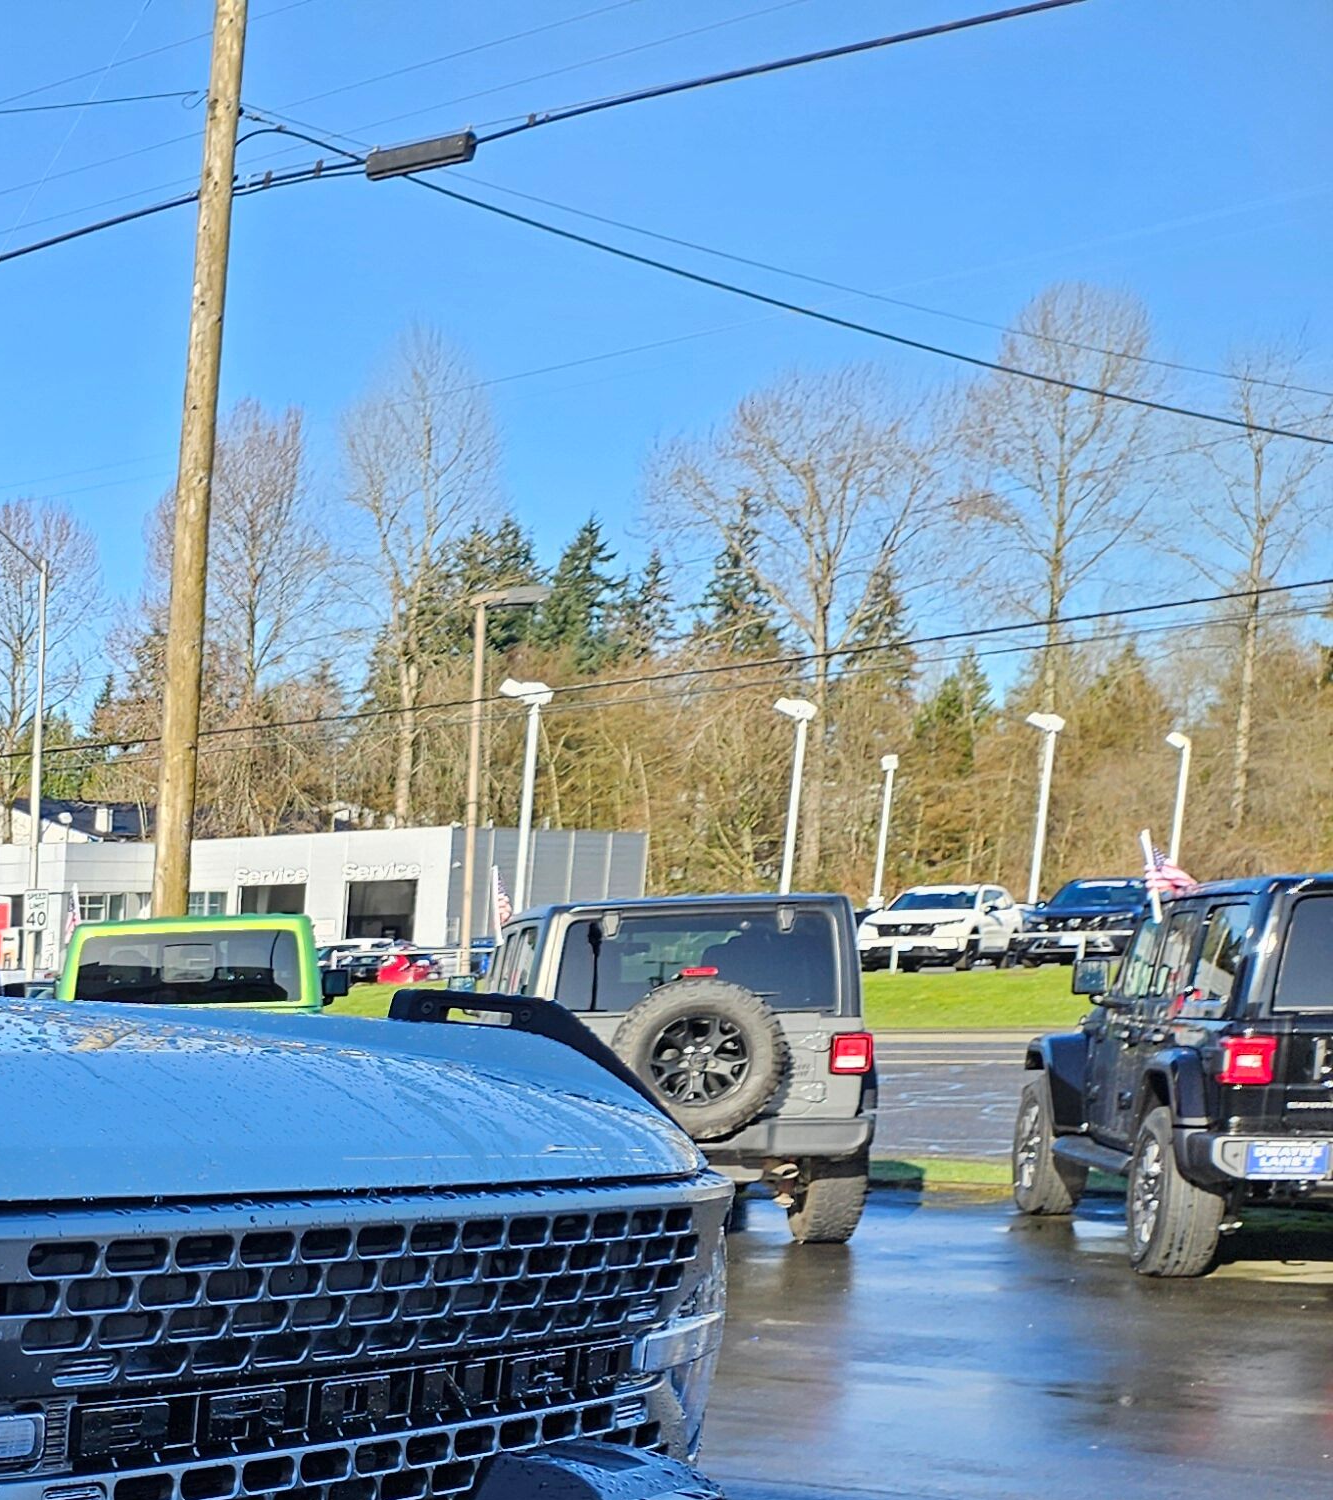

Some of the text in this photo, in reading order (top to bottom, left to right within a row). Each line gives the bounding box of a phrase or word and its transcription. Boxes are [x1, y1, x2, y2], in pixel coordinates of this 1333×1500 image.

[235, 866, 309, 885] Service
[341, 862, 421, 880] Service
[26, 911, 46, 926] 40
[77, 1342, 634, 1458] BRONCO
